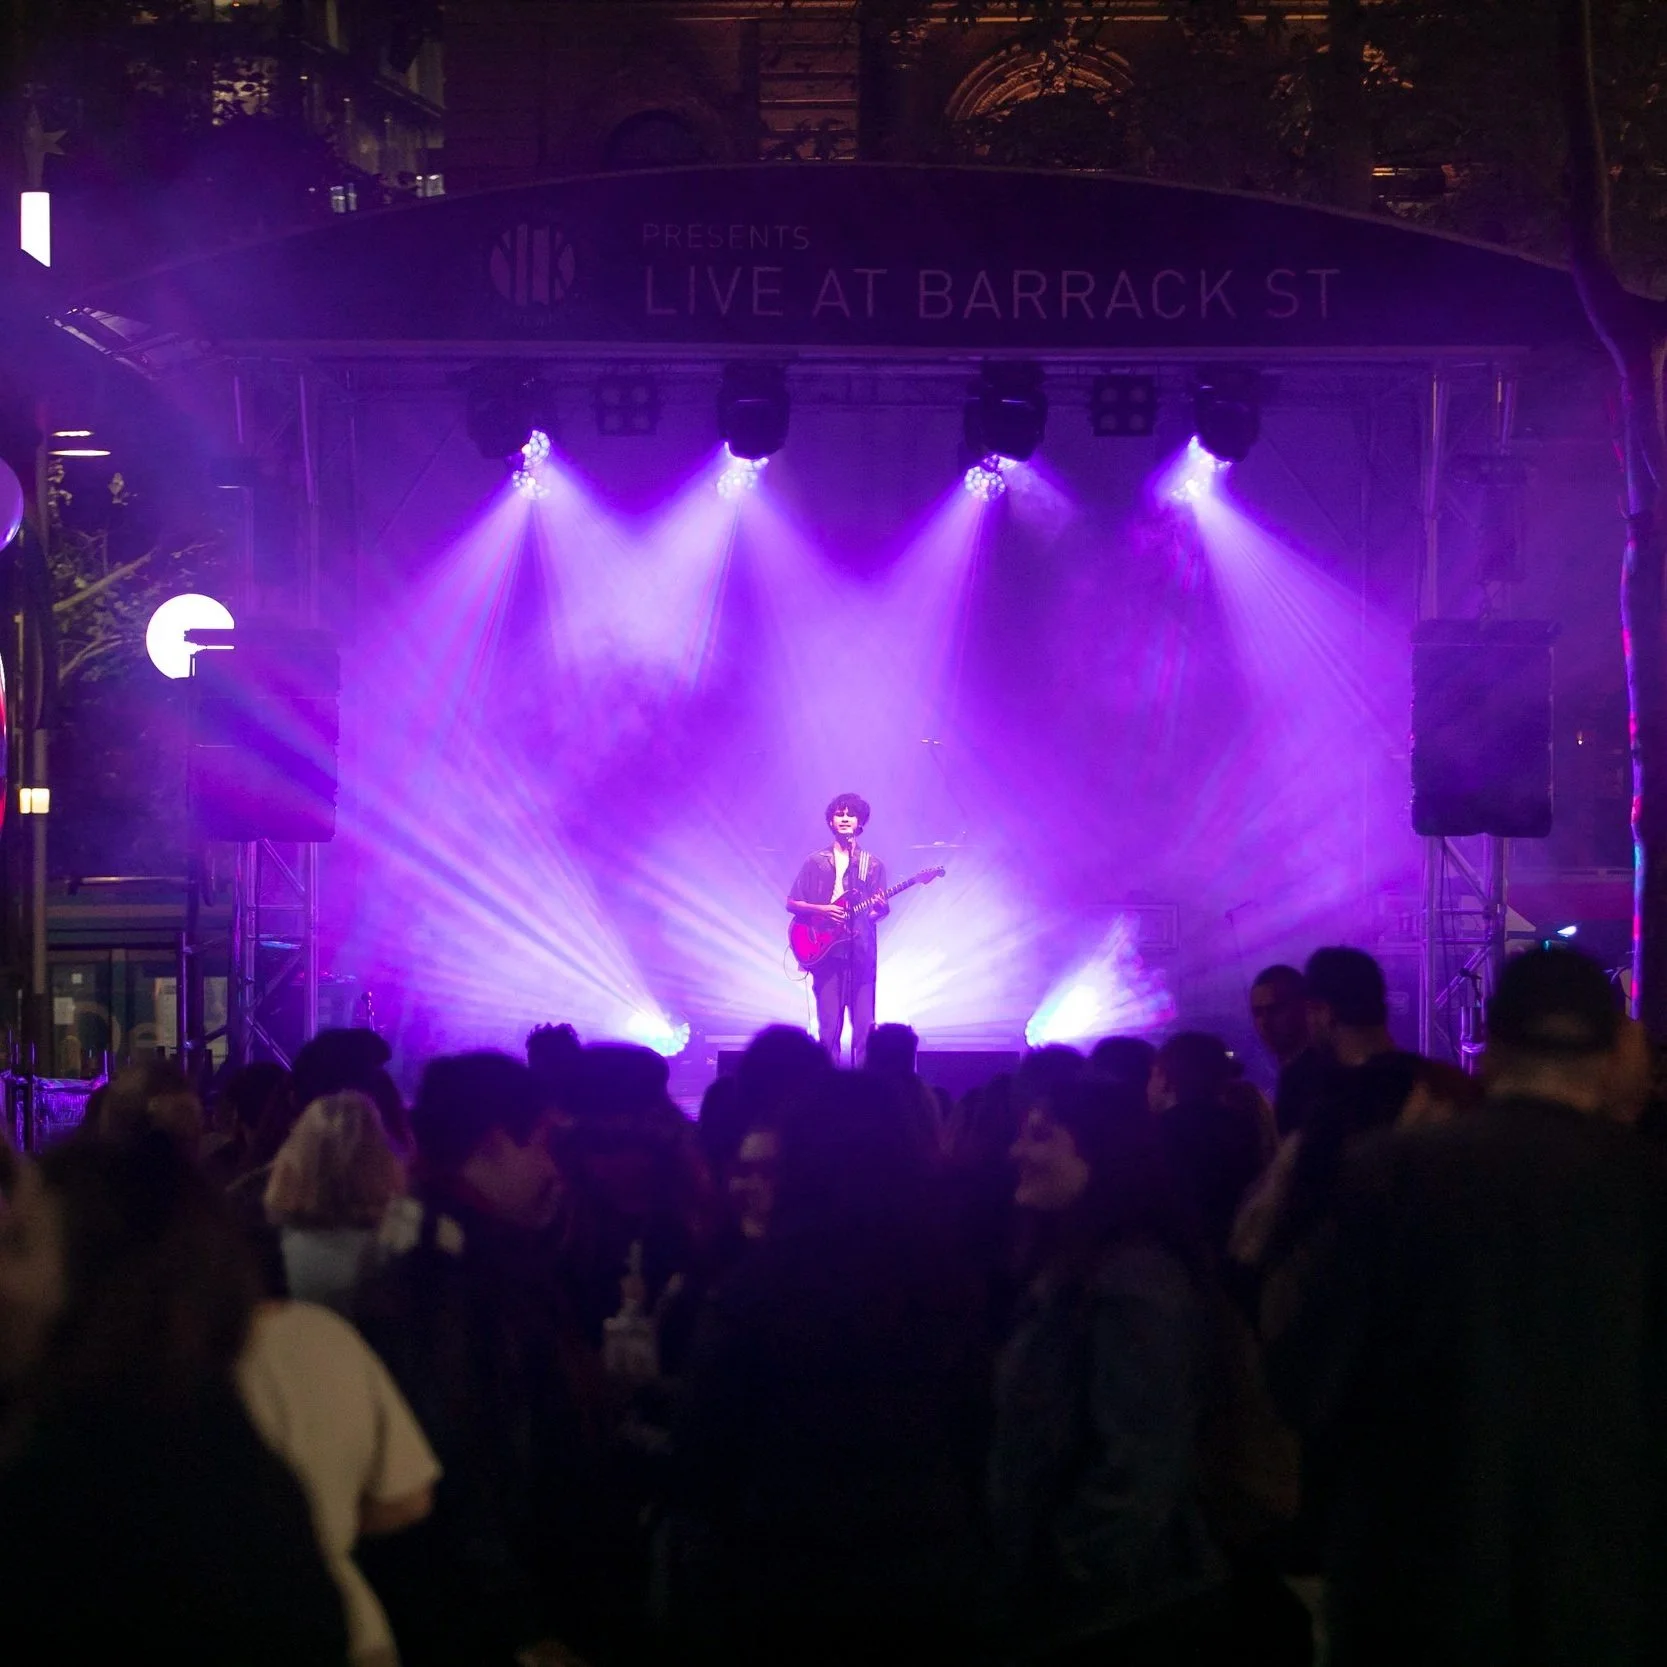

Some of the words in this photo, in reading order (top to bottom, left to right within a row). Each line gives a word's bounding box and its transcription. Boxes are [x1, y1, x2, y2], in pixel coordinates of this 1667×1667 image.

[642, 222, 811, 250] PRESENTS
[645, 264, 785, 318] LIVE
[811, 267, 889, 320] AT
[917, 268, 1238, 321] BARRACK
[1264, 268, 1341, 319] ST
